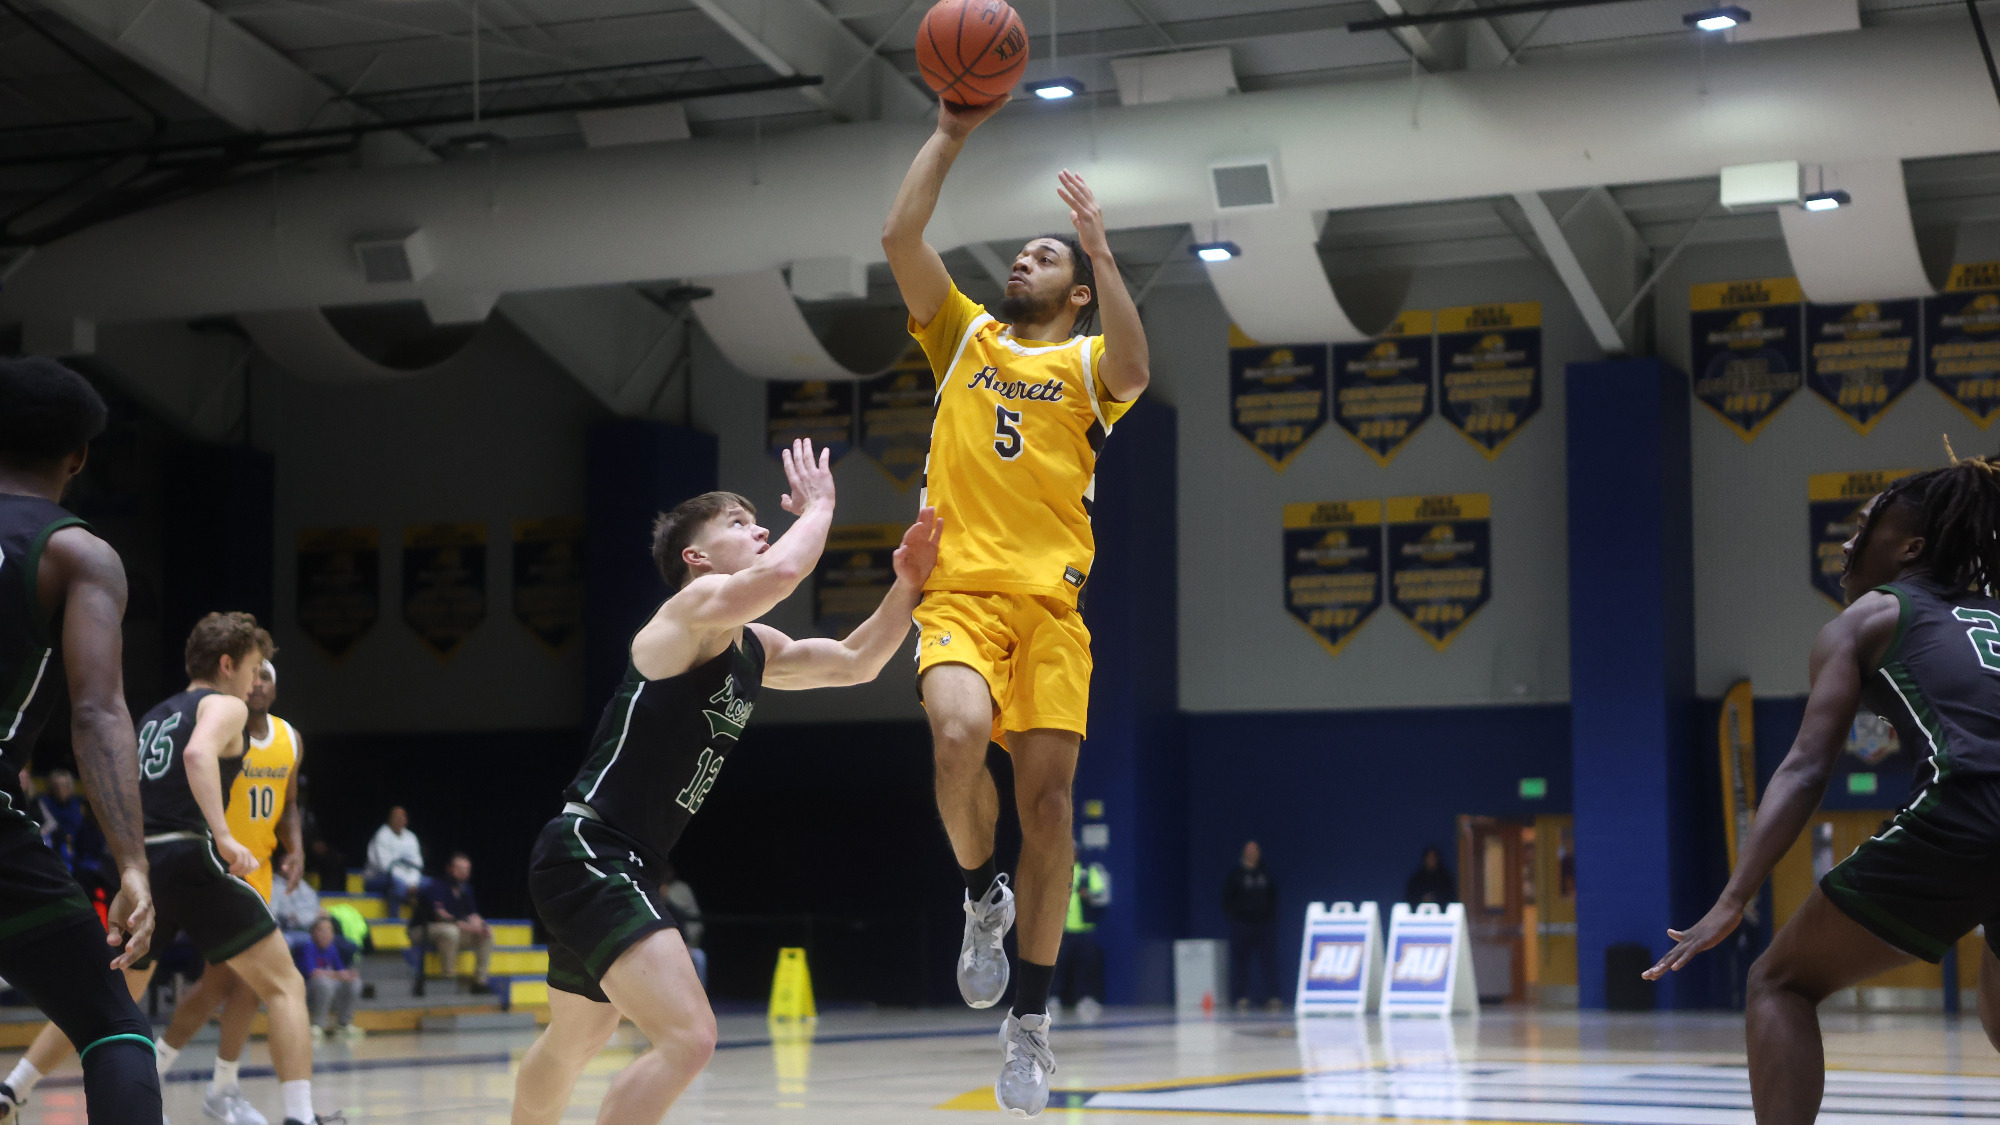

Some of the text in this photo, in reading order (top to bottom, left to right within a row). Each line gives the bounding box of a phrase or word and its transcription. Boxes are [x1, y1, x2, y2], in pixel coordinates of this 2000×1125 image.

[967, 366, 1064, 402] Averett
[993, 403, 1024, 461] 5
[138, 711, 182, 780] 15
[248, 783, 275, 821] 10
[1309, 944, 1364, 980] AU
[1394, 945, 1451, 981] AU
